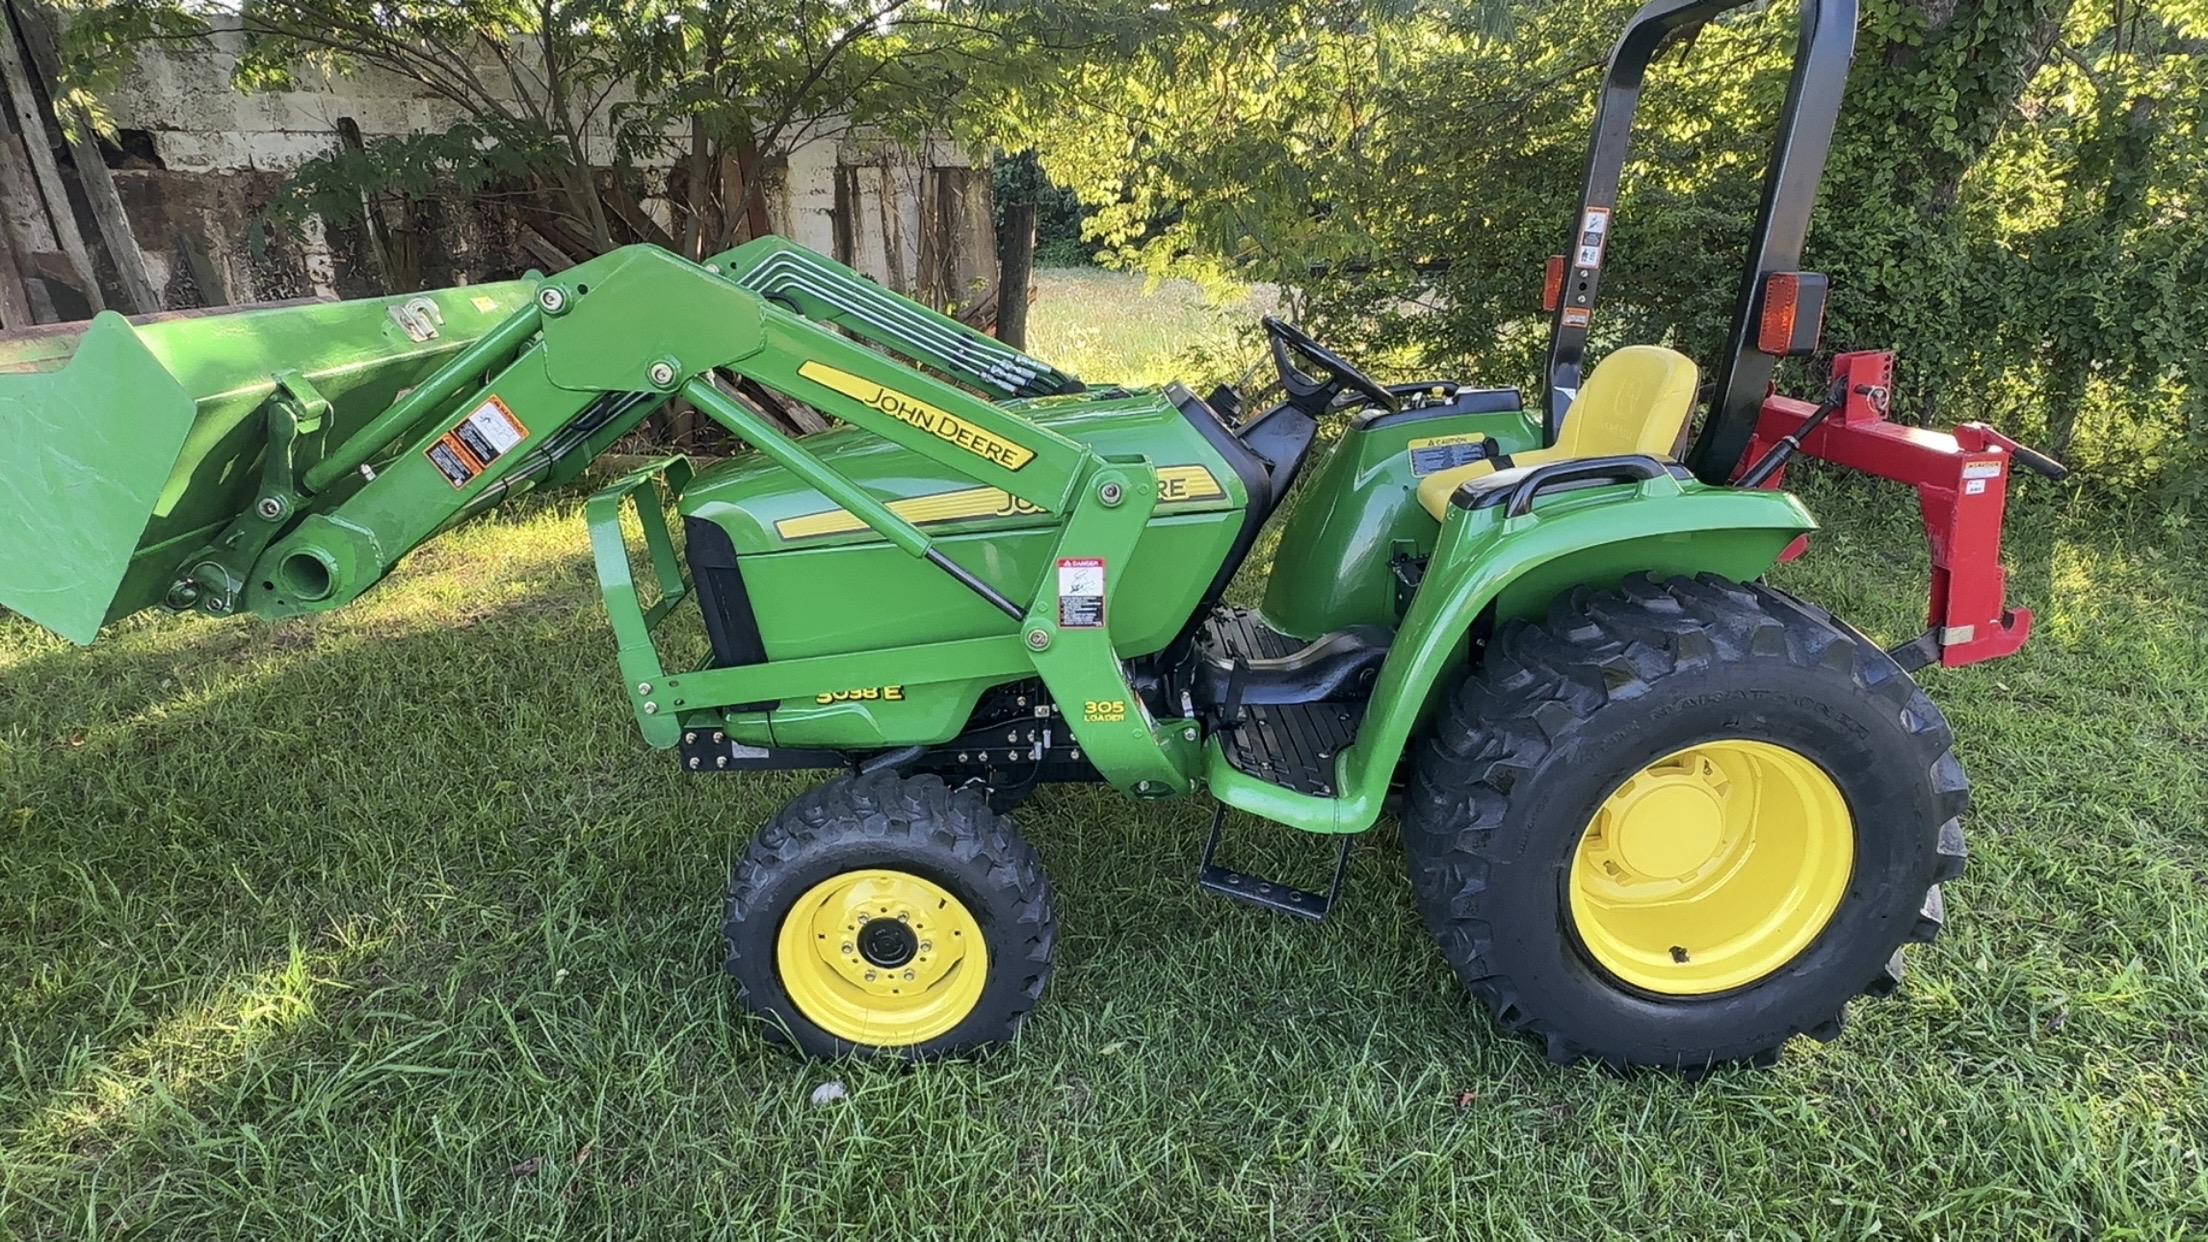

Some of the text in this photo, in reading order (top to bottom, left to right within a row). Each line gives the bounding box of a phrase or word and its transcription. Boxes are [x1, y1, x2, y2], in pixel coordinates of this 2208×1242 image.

[865, 388, 1019, 467] JOHN DEERE
[996, 493, 1035, 513] JO
[883, 685, 904, 700] E
[1084, 701, 1125, 713] 305
[1084, 714, 1125, 722] LOADER
